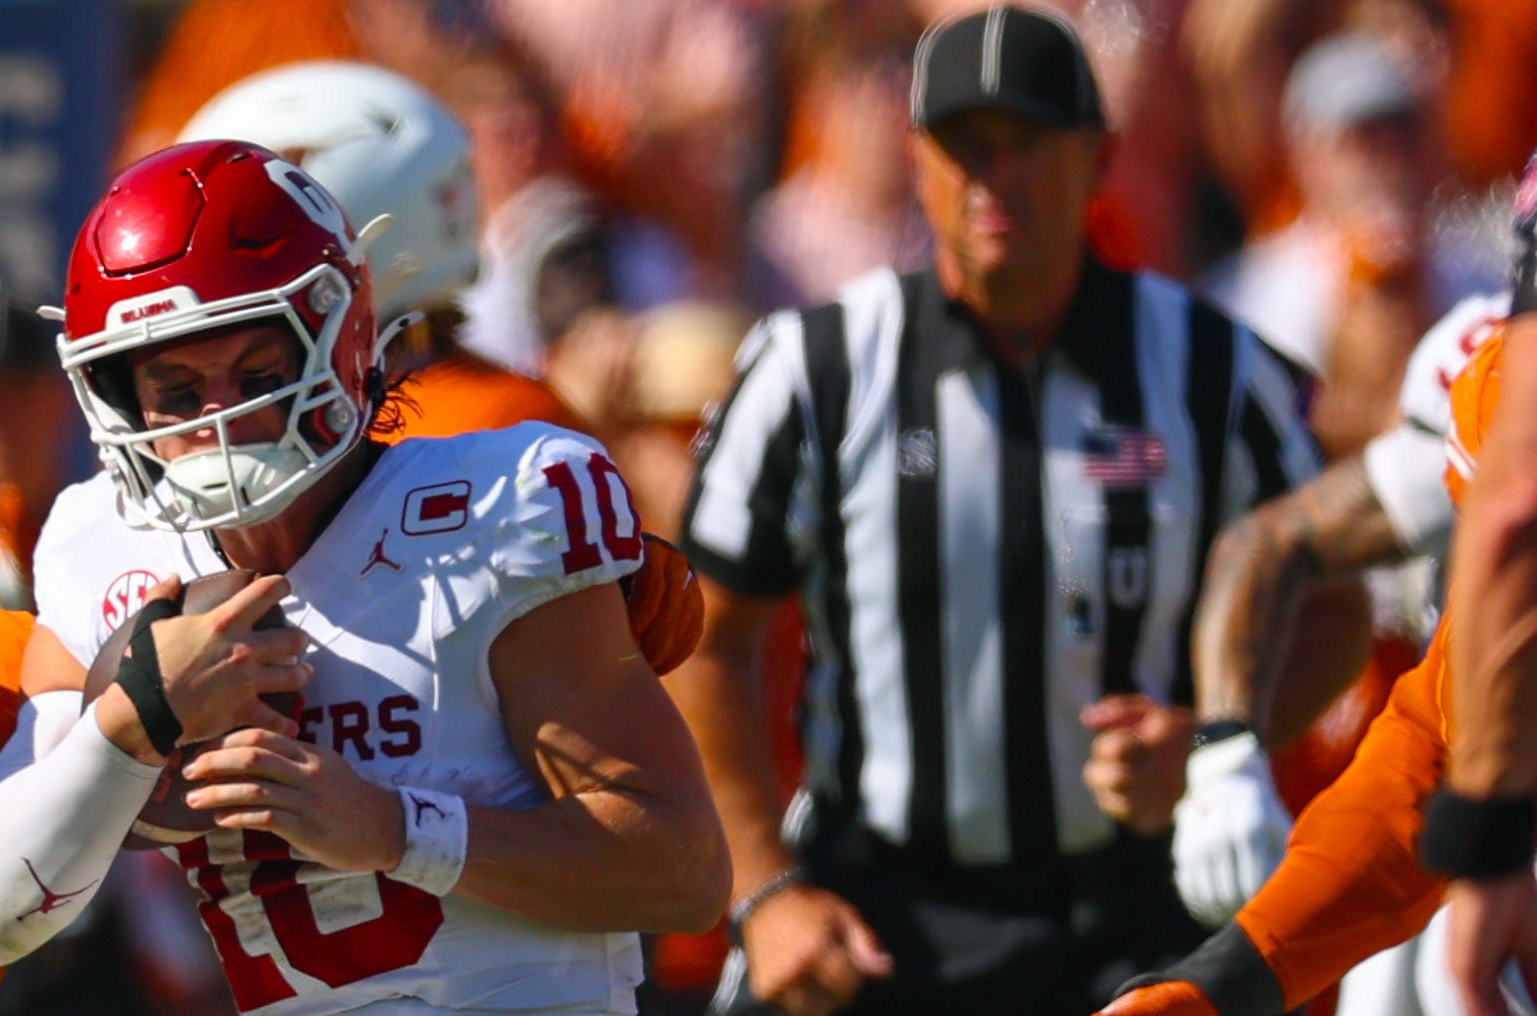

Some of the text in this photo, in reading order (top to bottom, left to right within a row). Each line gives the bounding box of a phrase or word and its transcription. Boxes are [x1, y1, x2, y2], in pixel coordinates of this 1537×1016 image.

[401, 480, 472, 536] C
[541, 452, 643, 576] 10
[177, 828, 445, 1013] 10
